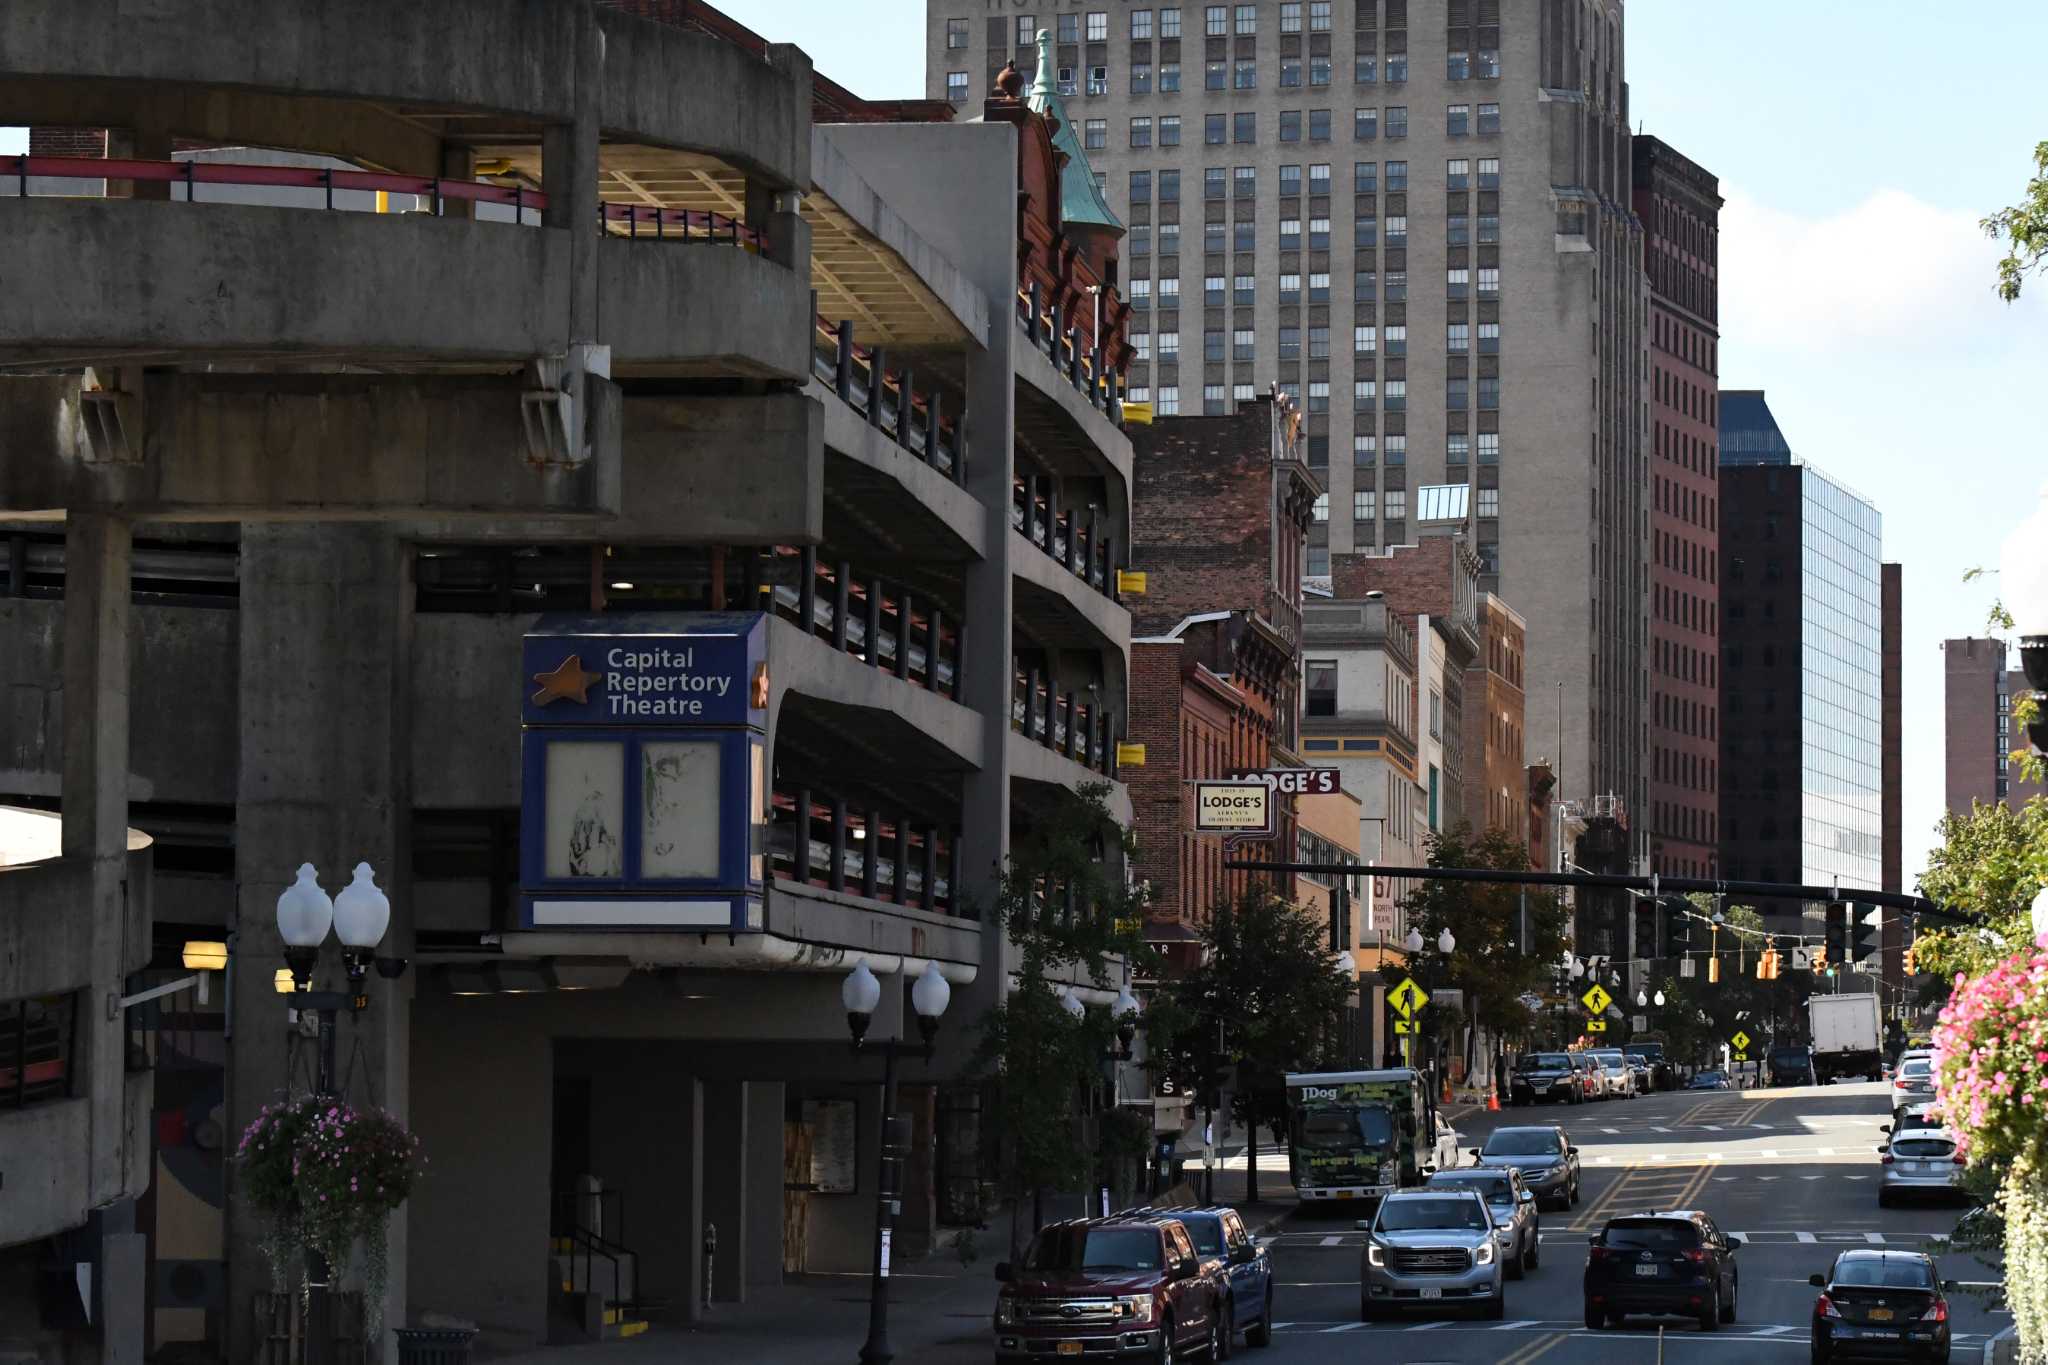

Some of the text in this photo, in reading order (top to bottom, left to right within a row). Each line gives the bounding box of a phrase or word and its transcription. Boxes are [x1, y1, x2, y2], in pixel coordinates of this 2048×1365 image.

[607, 647, 693, 673] Capital
[607, 672, 731, 696] Repertory
[607, 694, 703, 715] Theatre
[1203, 796, 1262, 808] LODGE'S
[1373, 903, 1393, 912] NORTH
[1301, 1086, 1338, 1102] JDog
